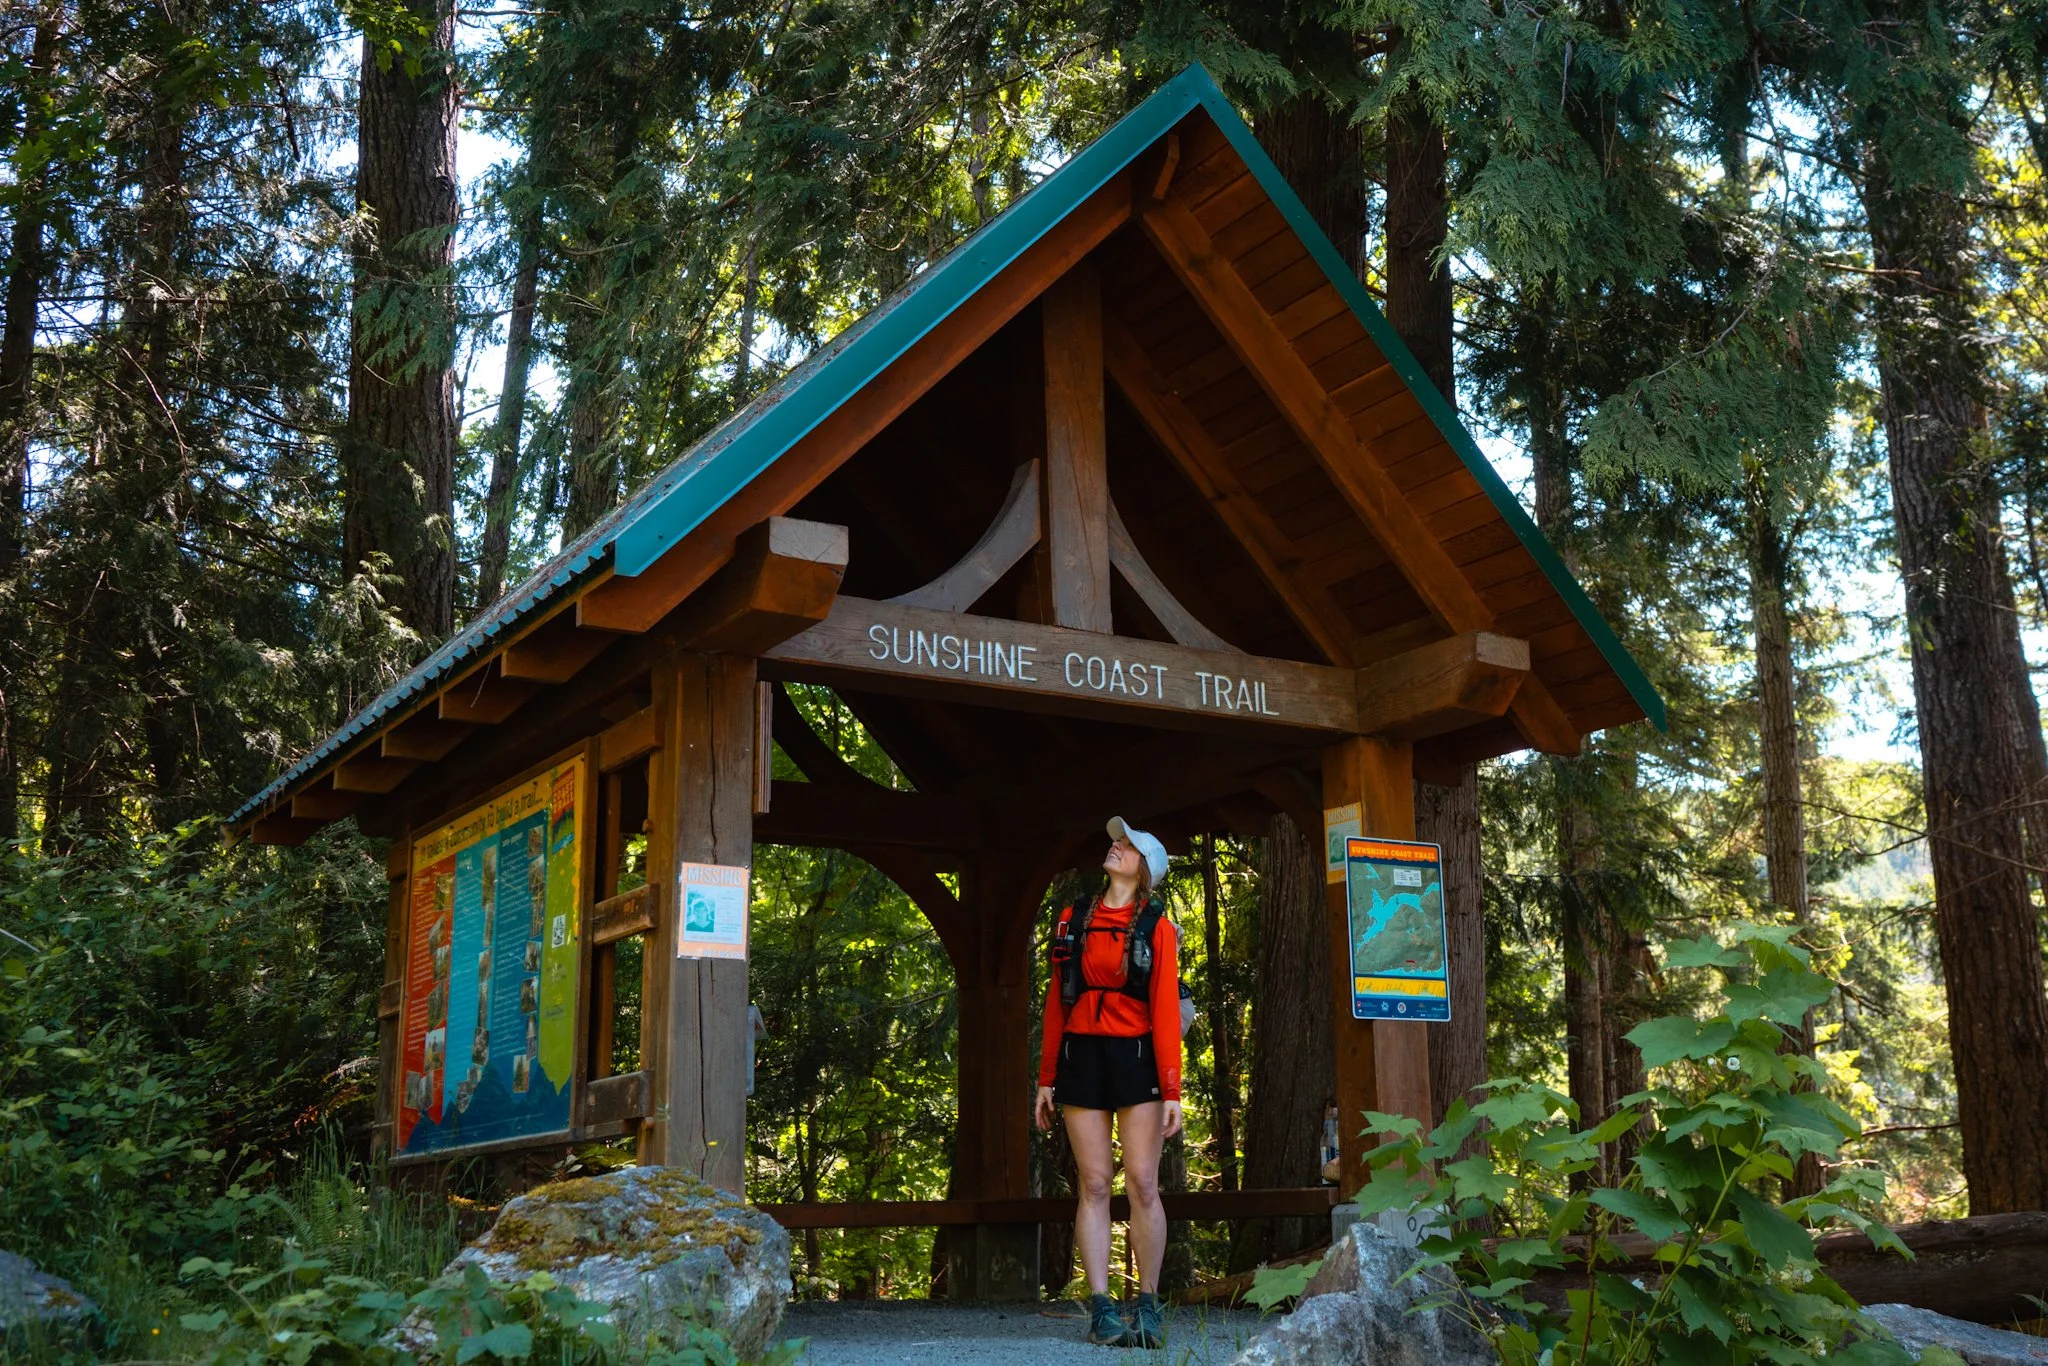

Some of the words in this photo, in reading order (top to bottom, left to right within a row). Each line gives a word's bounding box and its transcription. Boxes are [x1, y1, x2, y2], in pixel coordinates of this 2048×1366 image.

[869, 624, 1037, 682] SUNSHINE
[1064, 652, 1168, 699] COAST
[1195, 671, 1280, 716] TRAIL
[1328, 804, 1358, 824] MISSING
[1351, 846, 1389, 856] SUNSHINE
[1390, 849, 1412, 858] COAST
[1413, 851, 1436, 860] TRAIL
[688, 866, 741, 885] MISSING
